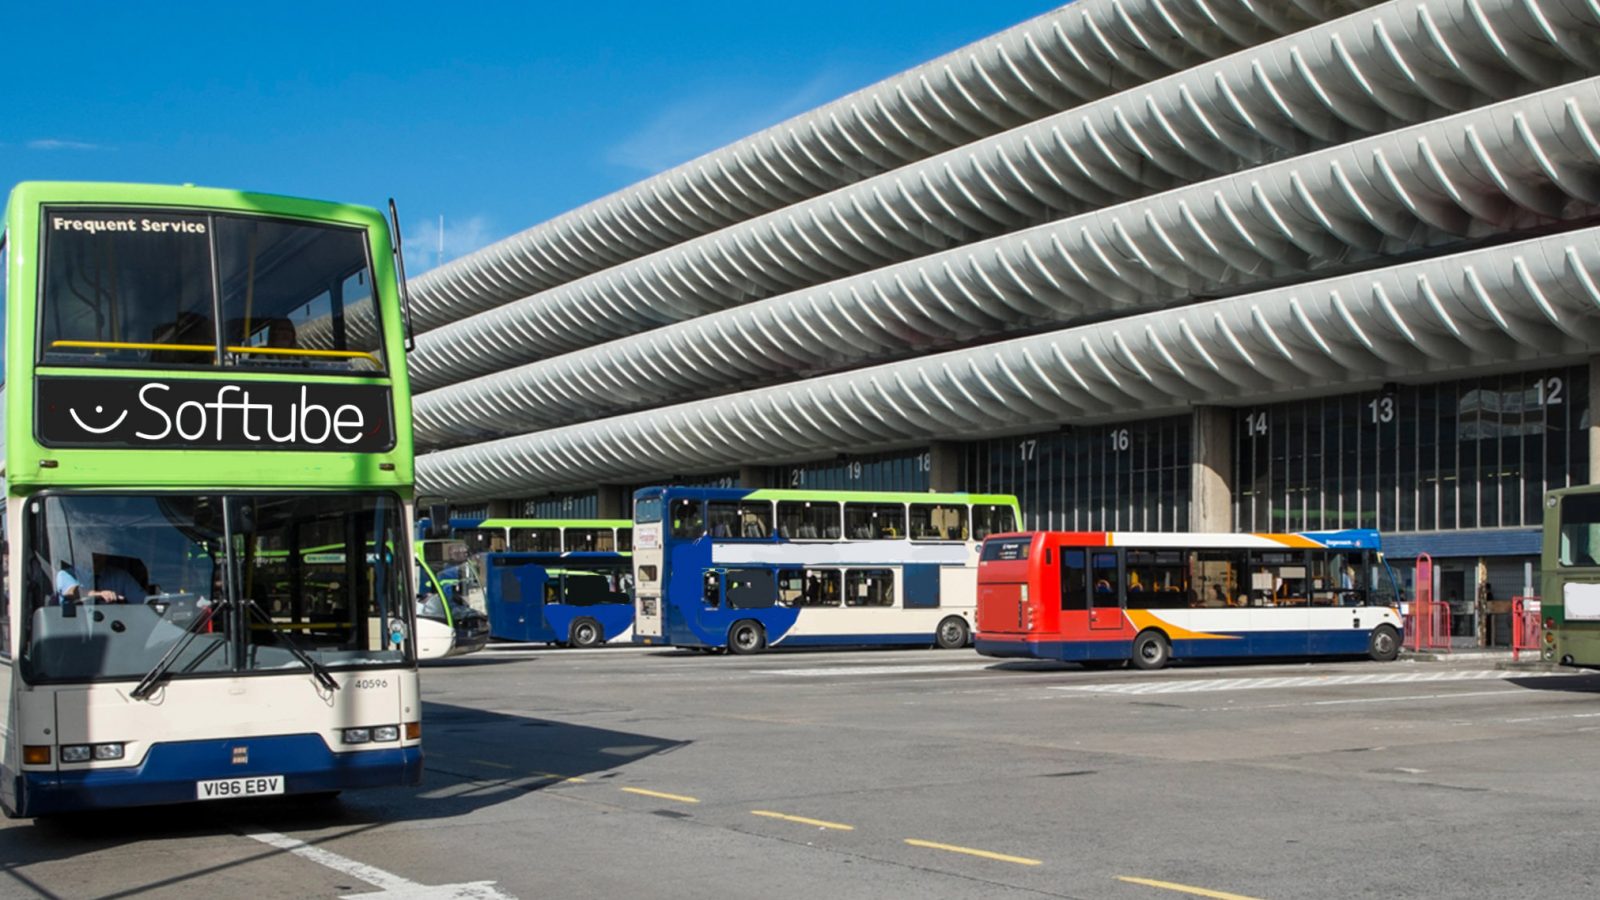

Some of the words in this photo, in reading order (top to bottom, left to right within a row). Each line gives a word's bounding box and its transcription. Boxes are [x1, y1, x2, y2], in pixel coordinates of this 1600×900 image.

[53, 217, 137, 234] Frequent
[141, 219, 206, 233] Service
[1534, 377, 1562, 405] 12
[135, 383, 364, 444] Softube
[1368, 397, 1394, 424] 13
[1245, 412, 1268, 436] 14
[1110, 429, 1129, 451] 16
[1019, 440, 1036, 461] 17
[848, 461, 861, 479] 19
[916, 453, 931, 472] 18
[792, 468, 805, 486] 21
[355, 679, 389, 689] 40596
[204, 781, 241, 796] V196
[245, 778, 278, 794] EBV
